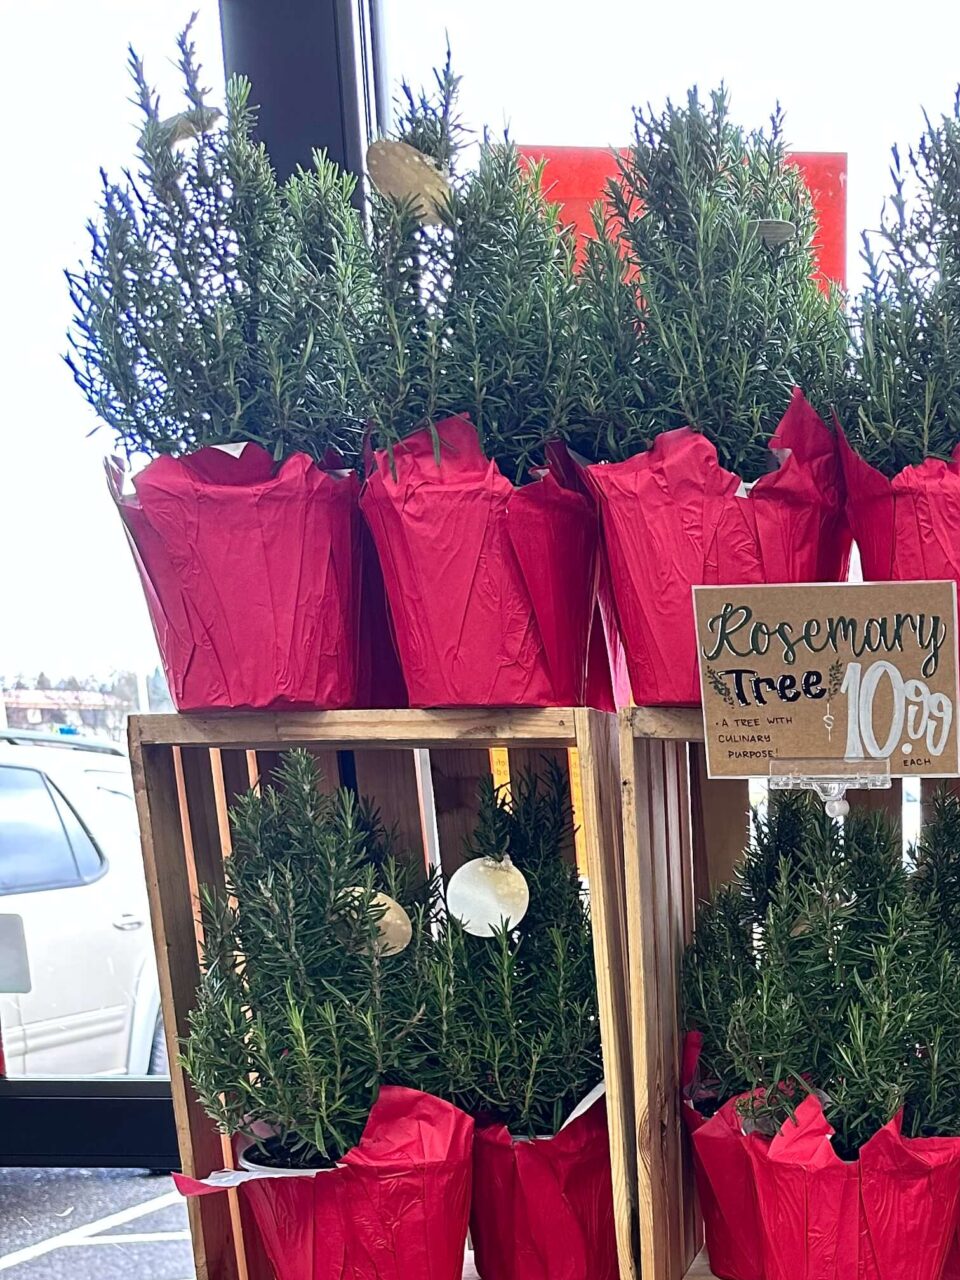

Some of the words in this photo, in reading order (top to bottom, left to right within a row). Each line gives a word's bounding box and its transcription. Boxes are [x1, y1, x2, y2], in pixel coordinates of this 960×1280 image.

[702, 603, 946, 678] Rosemary
[718, 668, 827, 707] Tree
[735, 717, 760, 727] TREE
[767, 716, 793, 725] WITH
[718, 734, 771, 744] CULINARY
[903, 758, 931, 767] EACH
